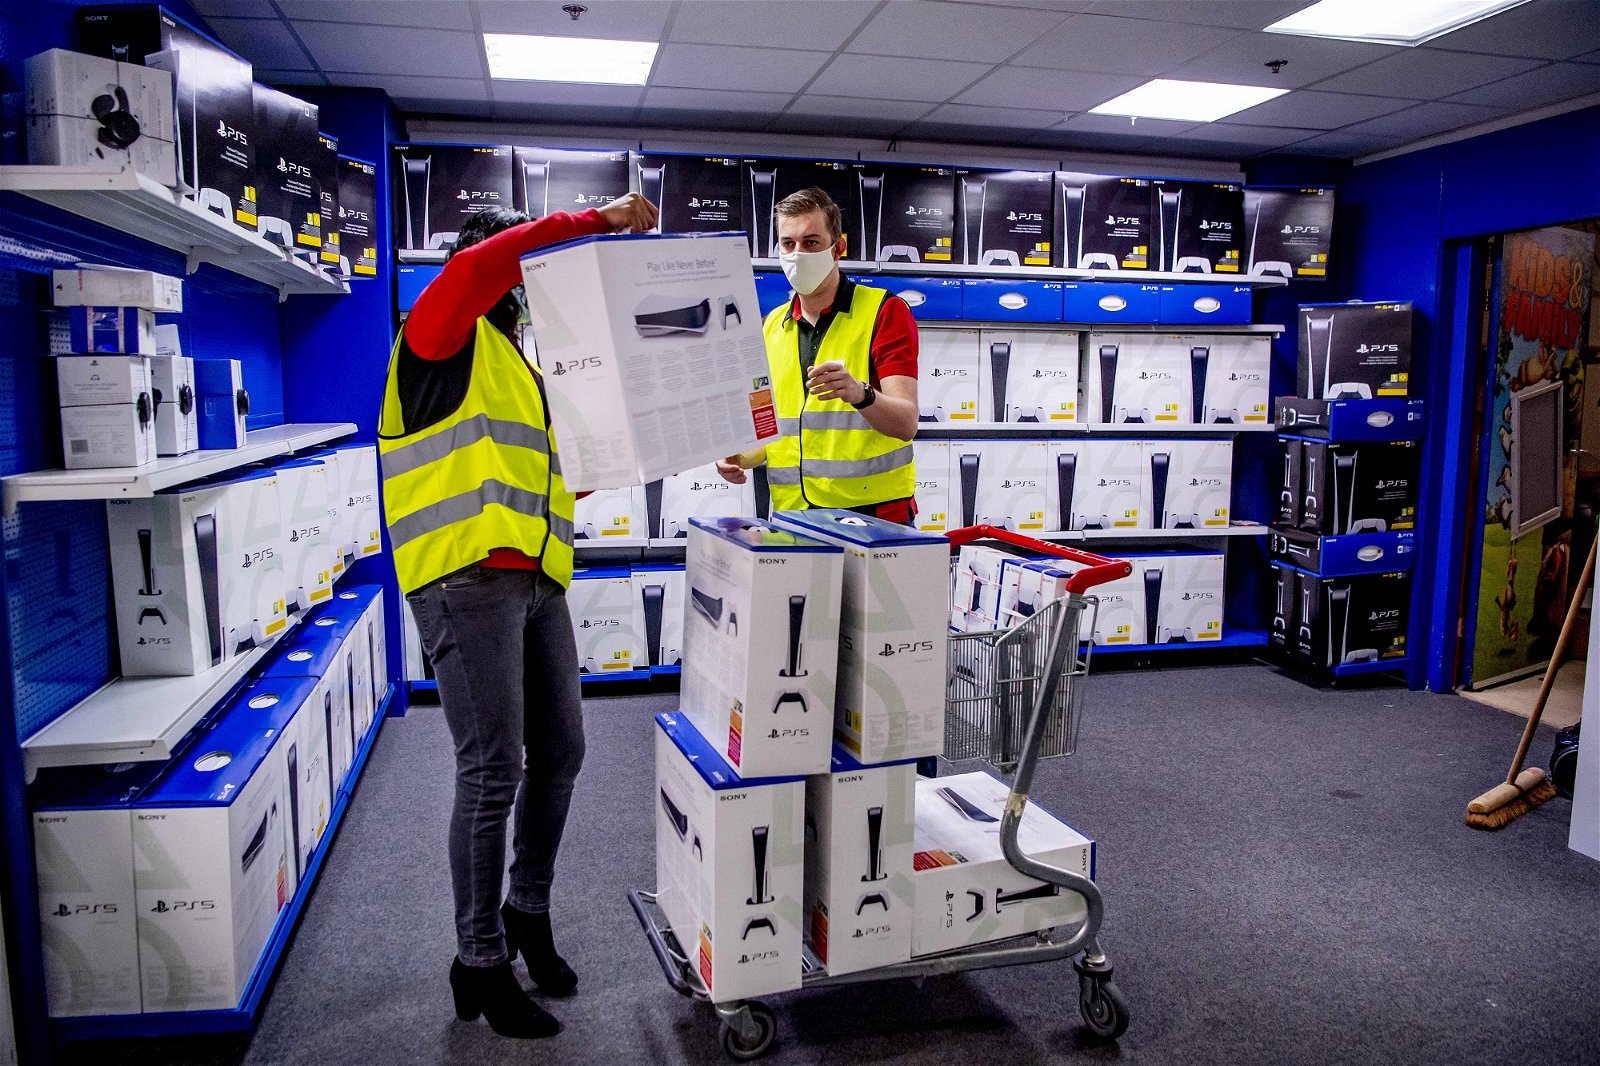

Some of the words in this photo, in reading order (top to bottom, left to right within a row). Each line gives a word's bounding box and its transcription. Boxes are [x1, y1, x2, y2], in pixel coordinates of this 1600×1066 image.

[227, 127, 248, 146] PS5
[289, 162, 311, 178] PS5
[320, 191, 331, 202] S5
[472, 191, 500, 199] PS5
[589, 195, 615, 203] PS5
[702, 199, 728, 207] PS5
[348, 209, 368, 221] PS5
[918, 207, 942, 215] PS5
[1018, 213, 1042, 221] PS5
[1117, 217, 1139, 225] PS5
[1294, 226, 1319, 234] PS5
[525, 261, 547, 273] SONY
[676, 260, 694, 270] Never
[1507, 237, 1571, 305] KIDS
[1568, 261, 1583, 309] &
[1505, 290, 1582, 350] FAMILY
[1371, 344, 1399, 352] PS5
[569, 356, 602, 371] PS5
[1239, 373, 1260, 381] PS5
[704, 482, 729, 490] PS5
[301, 526, 320, 538] PS5
[253, 548, 273, 563] PS5
[1379, 610, 1399, 618] PS5
[148, 637, 170, 645] PS5
[899, 641, 933, 653] PS5
[782, 729, 809, 737] PS5
[837, 775, 864, 783] SONY
[720, 793, 748, 801] SONY
[76, 904, 118, 915] PS5
[173, 900, 215, 911] PS5
[866, 925, 891, 936] PS5
[753, 950, 779, 961] PS5
